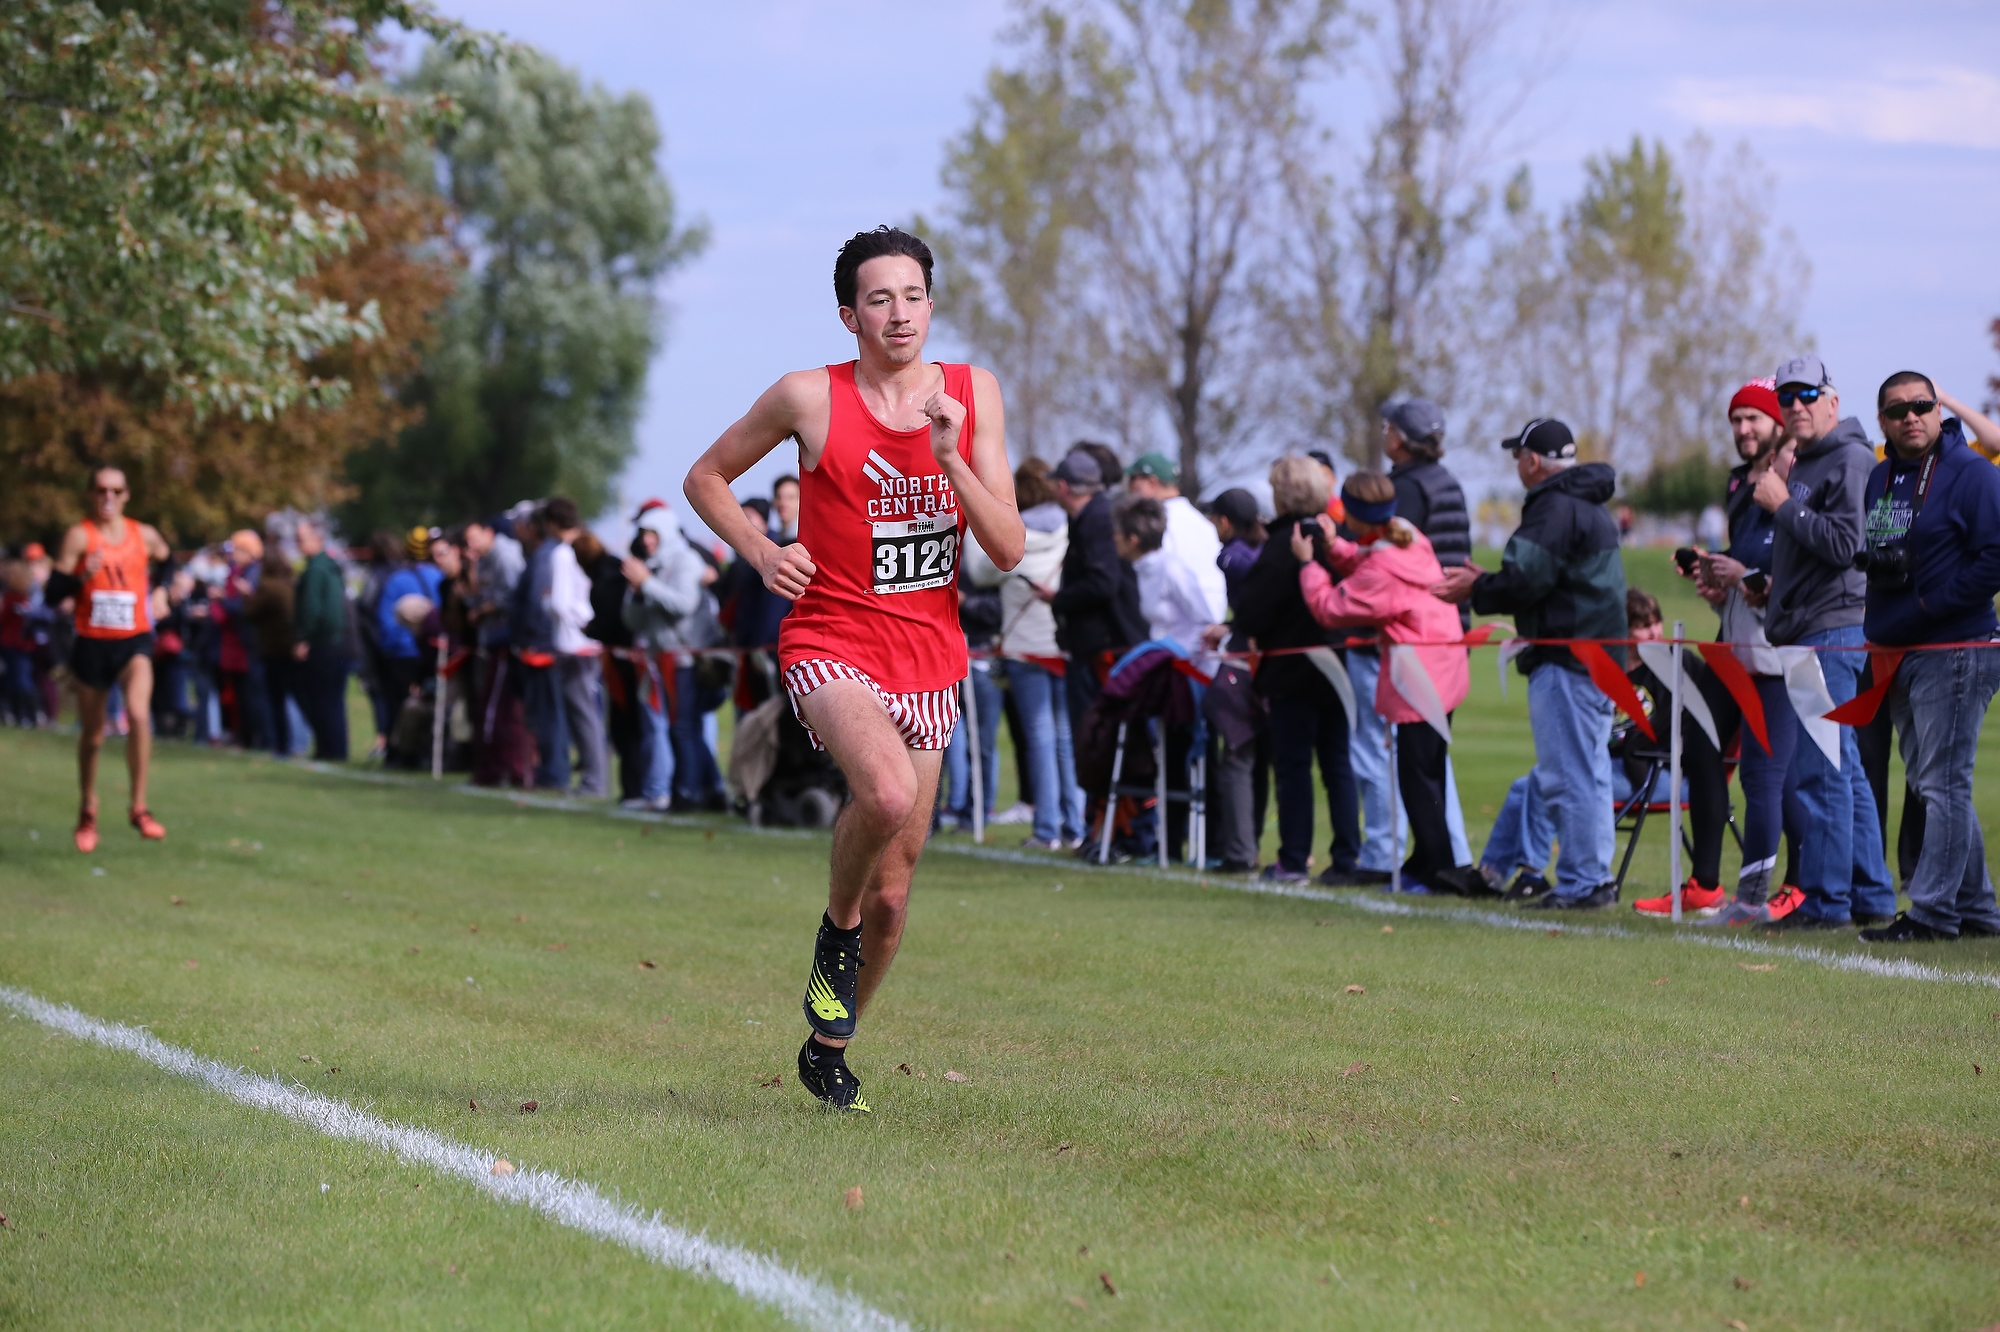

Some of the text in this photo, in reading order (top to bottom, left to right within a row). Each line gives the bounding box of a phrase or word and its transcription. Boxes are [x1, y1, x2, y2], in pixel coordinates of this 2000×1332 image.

[879, 473, 949, 497] NORTH
[867, 490, 956, 517] CENTRAL
[876, 534, 955, 580] 3123
[898, 579, 940, 591] pttiming.com
